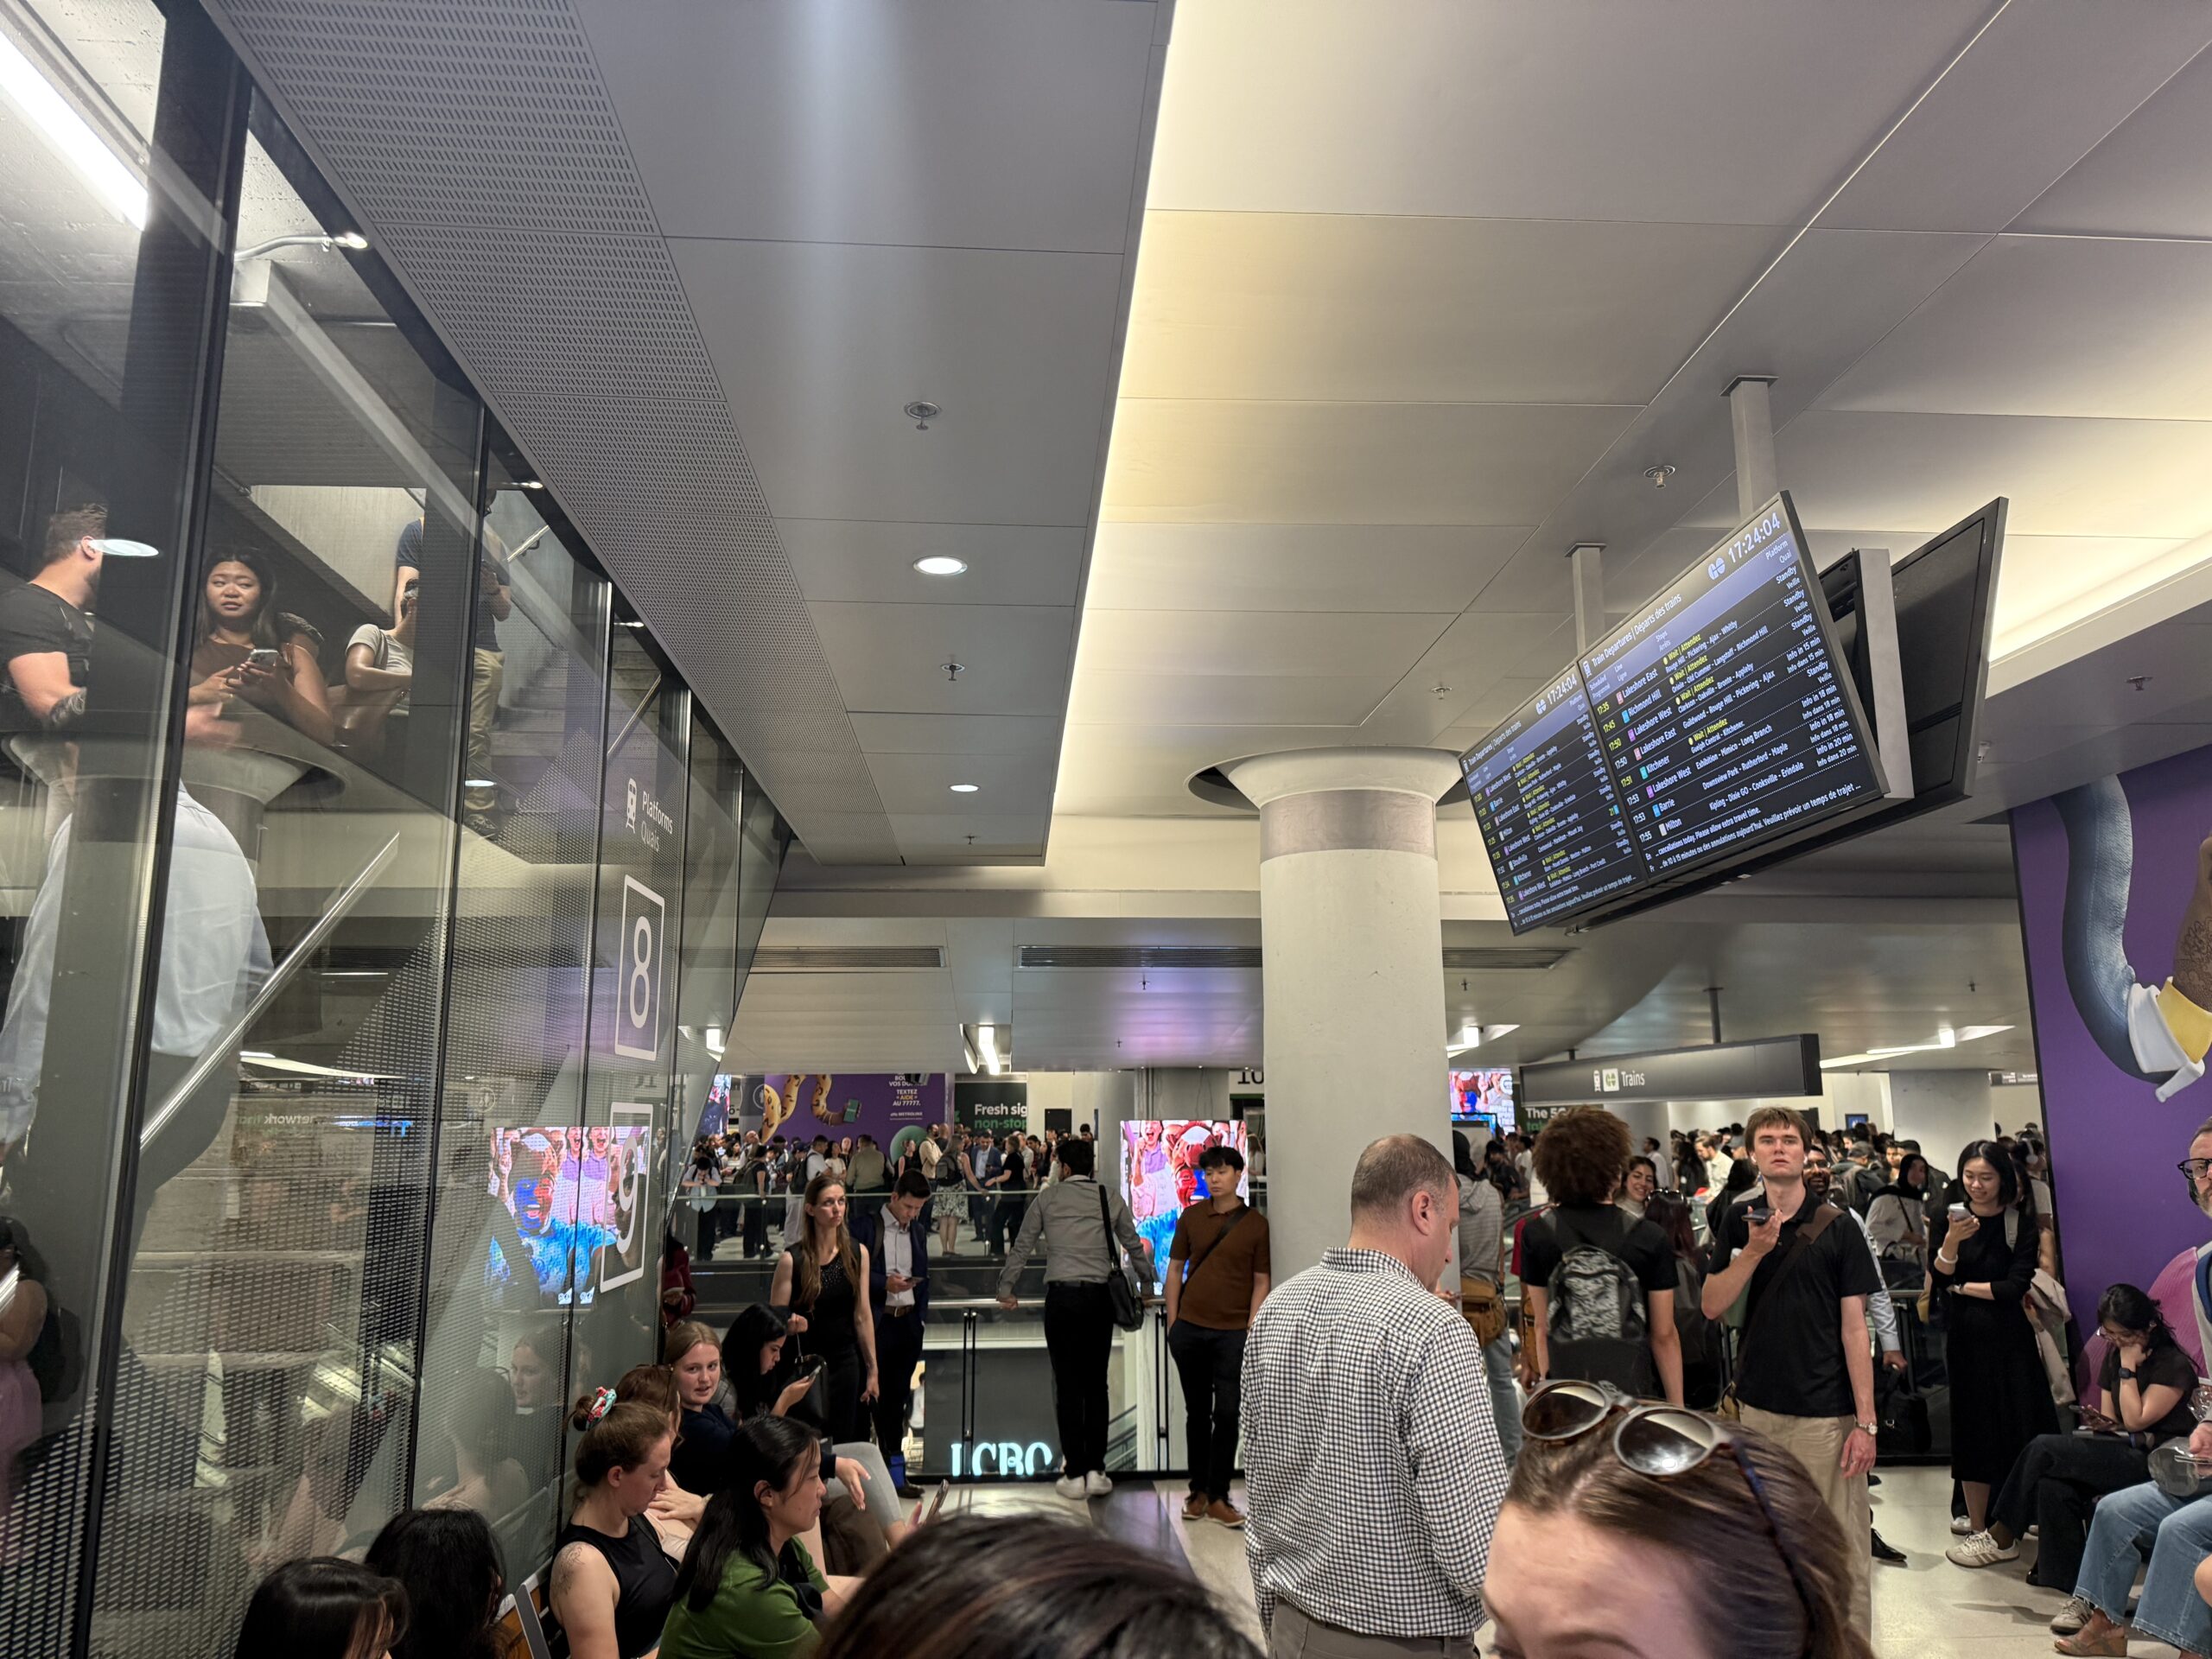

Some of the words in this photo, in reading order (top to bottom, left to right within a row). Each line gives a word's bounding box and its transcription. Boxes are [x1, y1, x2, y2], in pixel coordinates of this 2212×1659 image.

[1727, 512, 1780, 563] 17:24:04
[1765, 540, 1788, 560] Platform
[1779, 549, 1792, 563] Quai
[1776, 565, 1796, 584] Standby
[1786, 577, 1800, 589] Veille
[1783, 589, 1804, 607] Standby
[1794, 601, 1808, 613] Veille
[1592, 653, 1605, 667] Train
[1604, 632, 1632, 658] Departures
[1633, 613, 1656, 635] Départs
[1655, 606, 1665, 619] des
[1664, 594, 1681, 611] trains
[1790, 613, 1812, 630] Standby
[1802, 624, 1816, 636] Veille
[1665, 661, 1678, 673] Rouge
[1687, 641, 1707, 658] Pickering
[1709, 633, 1719, 644] Ajax
[1720, 620, 1738, 634] Whitby
[1667, 649, 1679, 660] Wait
[1681, 633, 1700, 652] Attendez
[1713, 647, 1734, 666] Langstaff
[1736, 631, 1759, 652] Richmond
[1758, 625, 1768, 637] Hill
[1786, 650, 1797, 661] Info
[1674, 669, 1685, 681] Wait
[1687, 655, 1707, 672] Attendez
[1787, 664, 1797, 673] Info
[1796, 658, 1808, 668] dans
[1806, 660, 1828, 677] Standby
[1622, 677, 1647, 698] Lakeshore
[1645, 668, 1657, 682] East
[1817, 671, 1832, 683] Veille
[1547, 672, 1577, 704] 17:24:04
[1678, 699, 1695, 713] Clarkson
[1697, 687, 1715, 701] Oakville
[1717, 676, 1732, 690] Bronte
[1735, 663, 1753, 678] Appleby
[1680, 690, 1692, 701] Wait
[1694, 676, 1714, 693] Attendez
[1597, 701, 1609, 715] 17:35
[1627, 695, 1652, 716] Richmond
[1650, 689, 1662, 702] Hill
[1682, 709, 1706, 728] Guildwood
[1708, 700, 1725, 714] Rouge
[1723, 694, 1732, 705] Hill
[1735, 679, 1759, 698] Pickering
[1762, 671, 1775, 683] Ajax
[1801, 696, 1813, 708] Info
[1633, 715, 1659, 735] Lakeshore
[1657, 706, 1672, 721] West
[1802, 710, 1813, 720] Info
[1812, 704, 1824, 715] dans
[1603, 719, 1616, 733] 17:45
[1693, 730, 1704, 741] Wait
[1707, 718, 1727, 734] Attendez
[1808, 721, 1821, 731] Info
[1639, 735, 1665, 754] Lakeshore
[1663, 728, 1676, 741] East
[1704, 732, 1720, 746] Central
[1809, 734, 1821, 743] Info
[1820, 728, 1832, 738] dans
[1695, 753, 1719, 770] Exhibition
[1720, 743, 1738, 756] Mimico
[1740, 734, 1754, 746] Long
[1752, 724, 1772, 740] Branch
[1815, 744, 1827, 754] Info
[1614, 756, 1627, 769] 17:50
[1645, 755, 1669, 773] Kitchener
[1702, 772, 1728, 790] Downsview
[1726, 766, 1739, 778] Park
[1741, 751, 1769, 771] Rutherford
[1770, 742, 1789, 756] Maple
[1816, 758, 1827, 767] Info
[1827, 753, 1840, 762] dans
[1620, 775, 1632, 787] 17:51
[1652, 774, 1678, 792] Lakeshore
[1676, 766, 1692, 779] West
[1708, 798, 1726, 810] Kipling
[1727, 791, 1741, 802] Dixie
[1739, 786, 1749, 796] GO
[1751, 773, 1778, 791] Cooksville
[1780, 761, 1804, 777] Erindale
[1626, 793, 1639, 805] 17:53
[1658, 798, 1675, 812] Barrie
[643, 790, 673, 835] Platforms
[1632, 811, 1646, 824] 17:53
[1702, 842, 1711, 851] des
[1762, 813, 1783, 826] Veuillez
[1783, 804, 1802, 820] prévoir
[1802, 802, 1810, 810] un
[1809, 794, 1828, 807] temps
[1828, 790, 1837, 799] de
[1836, 783, 1854, 797] trajet
[1658, 839, 1683, 855] cancellations
[1694, 828, 1710, 839] Please
[1709, 823, 1721, 833] allow
[1721, 817, 1733, 828] extra
[1732, 810, 1748, 823] travel
[1665, 818, 1681, 830] Milton
[641, 820, 659, 853] Quais
[1639, 830, 1652, 842] 17:55
[629, 916, 652, 1029] 8
[1621, 1071, 1645, 1087] Trains
[975, 1103, 1008, 1116] Fresh
[1525, 1107, 1548, 1119] The
[616, 1136, 638, 1254] 9
